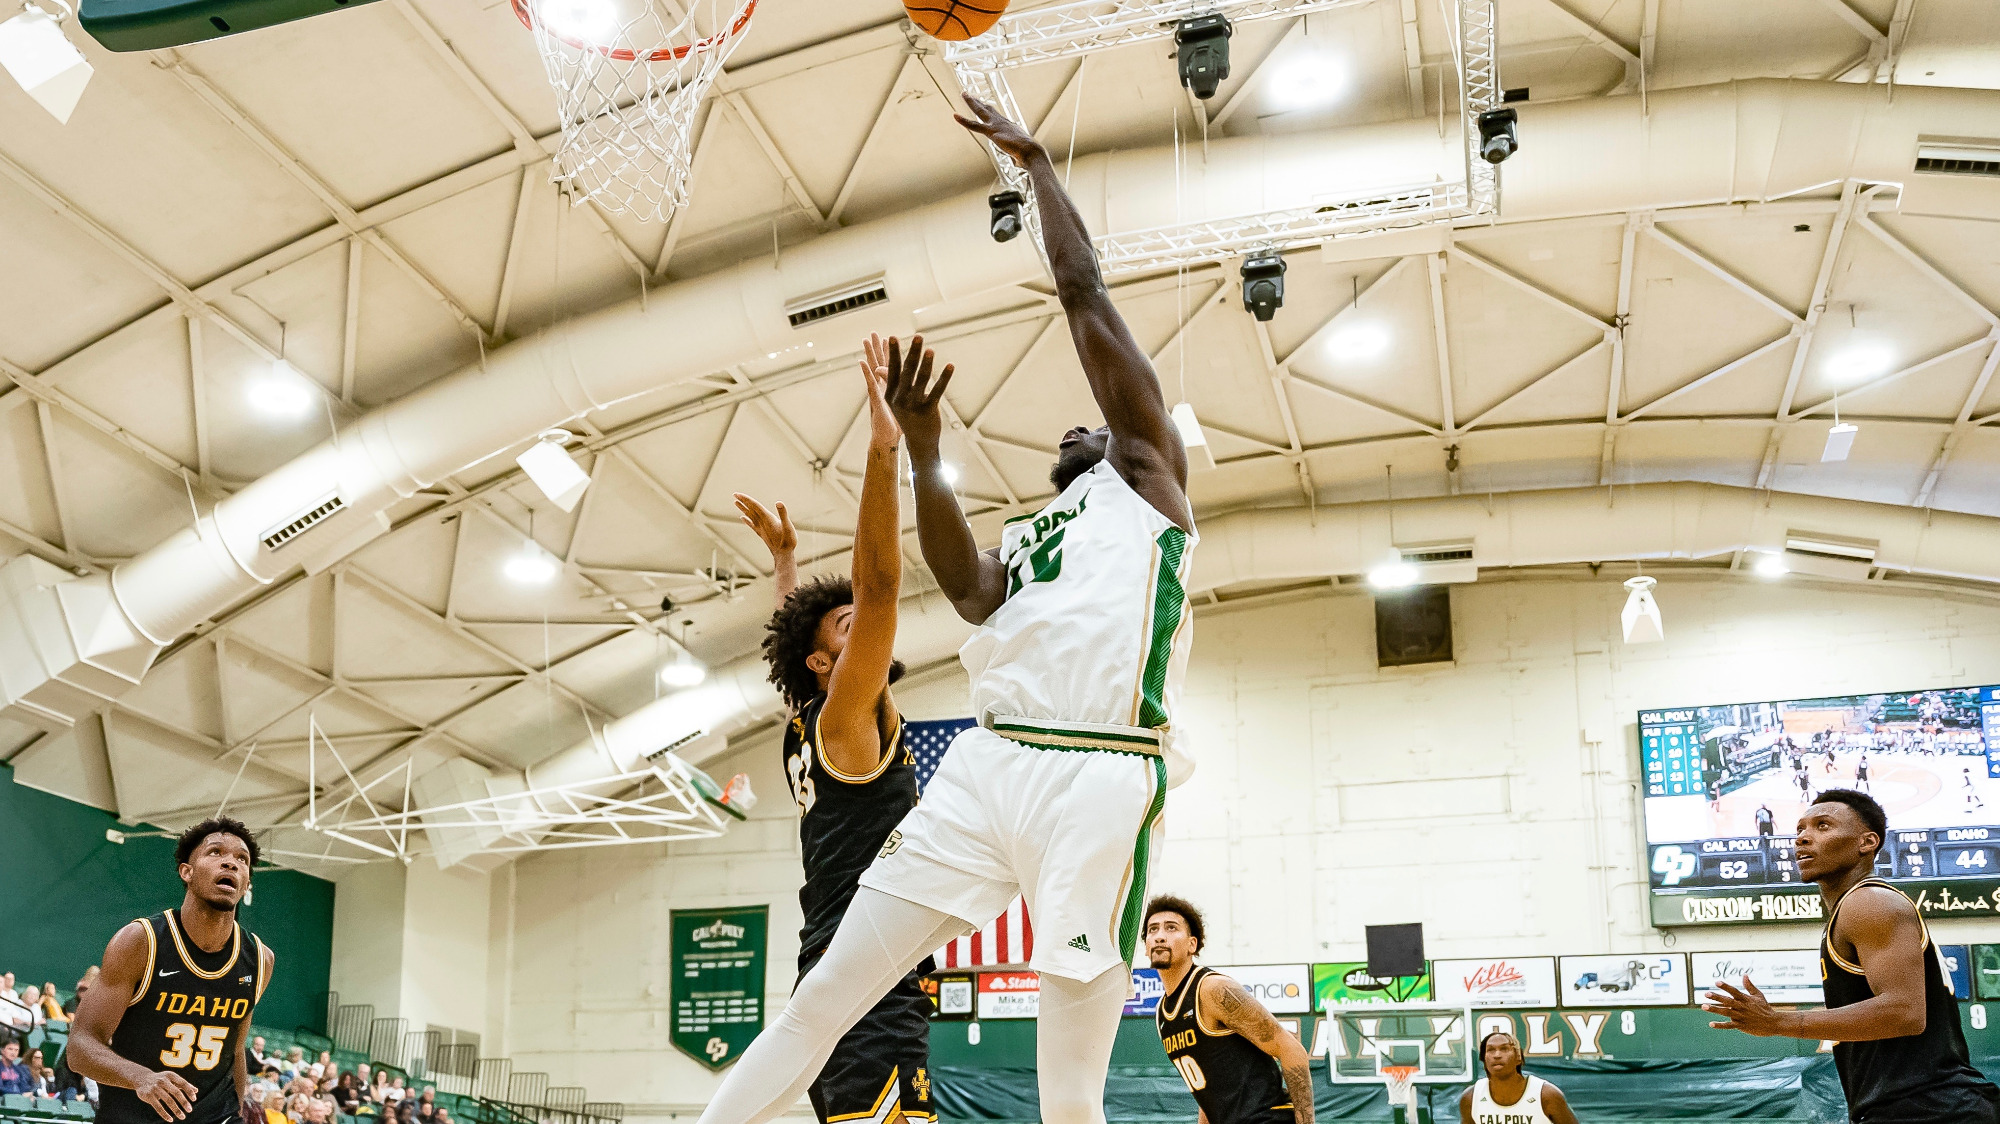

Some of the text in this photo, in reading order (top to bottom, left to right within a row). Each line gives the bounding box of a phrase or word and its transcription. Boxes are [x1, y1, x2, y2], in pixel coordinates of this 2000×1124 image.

[1641, 710, 1695, 723] CAL POLY
[1946, 828, 1989, 841] IDAHO
[1702, 838, 1760, 853] CAL POLY
[1955, 849, 1988, 869] 44
[1719, 860, 1749, 880] 52
[1067, 940, 1091, 953] adidas
[1463, 961, 1524, 993] Villa
[154, 992, 249, 1019] IDAHO
[998, 995, 1024, 1005] Mike
[1620, 1010, 1636, 1035] 8
[1969, 1003, 1987, 1030] 9
[1427, 1011, 1612, 1060] POLY
[160, 1022, 230, 1071] 35
[1172, 1055, 1207, 1093] 10
[1504, 1114, 1534, 1124] POLY
